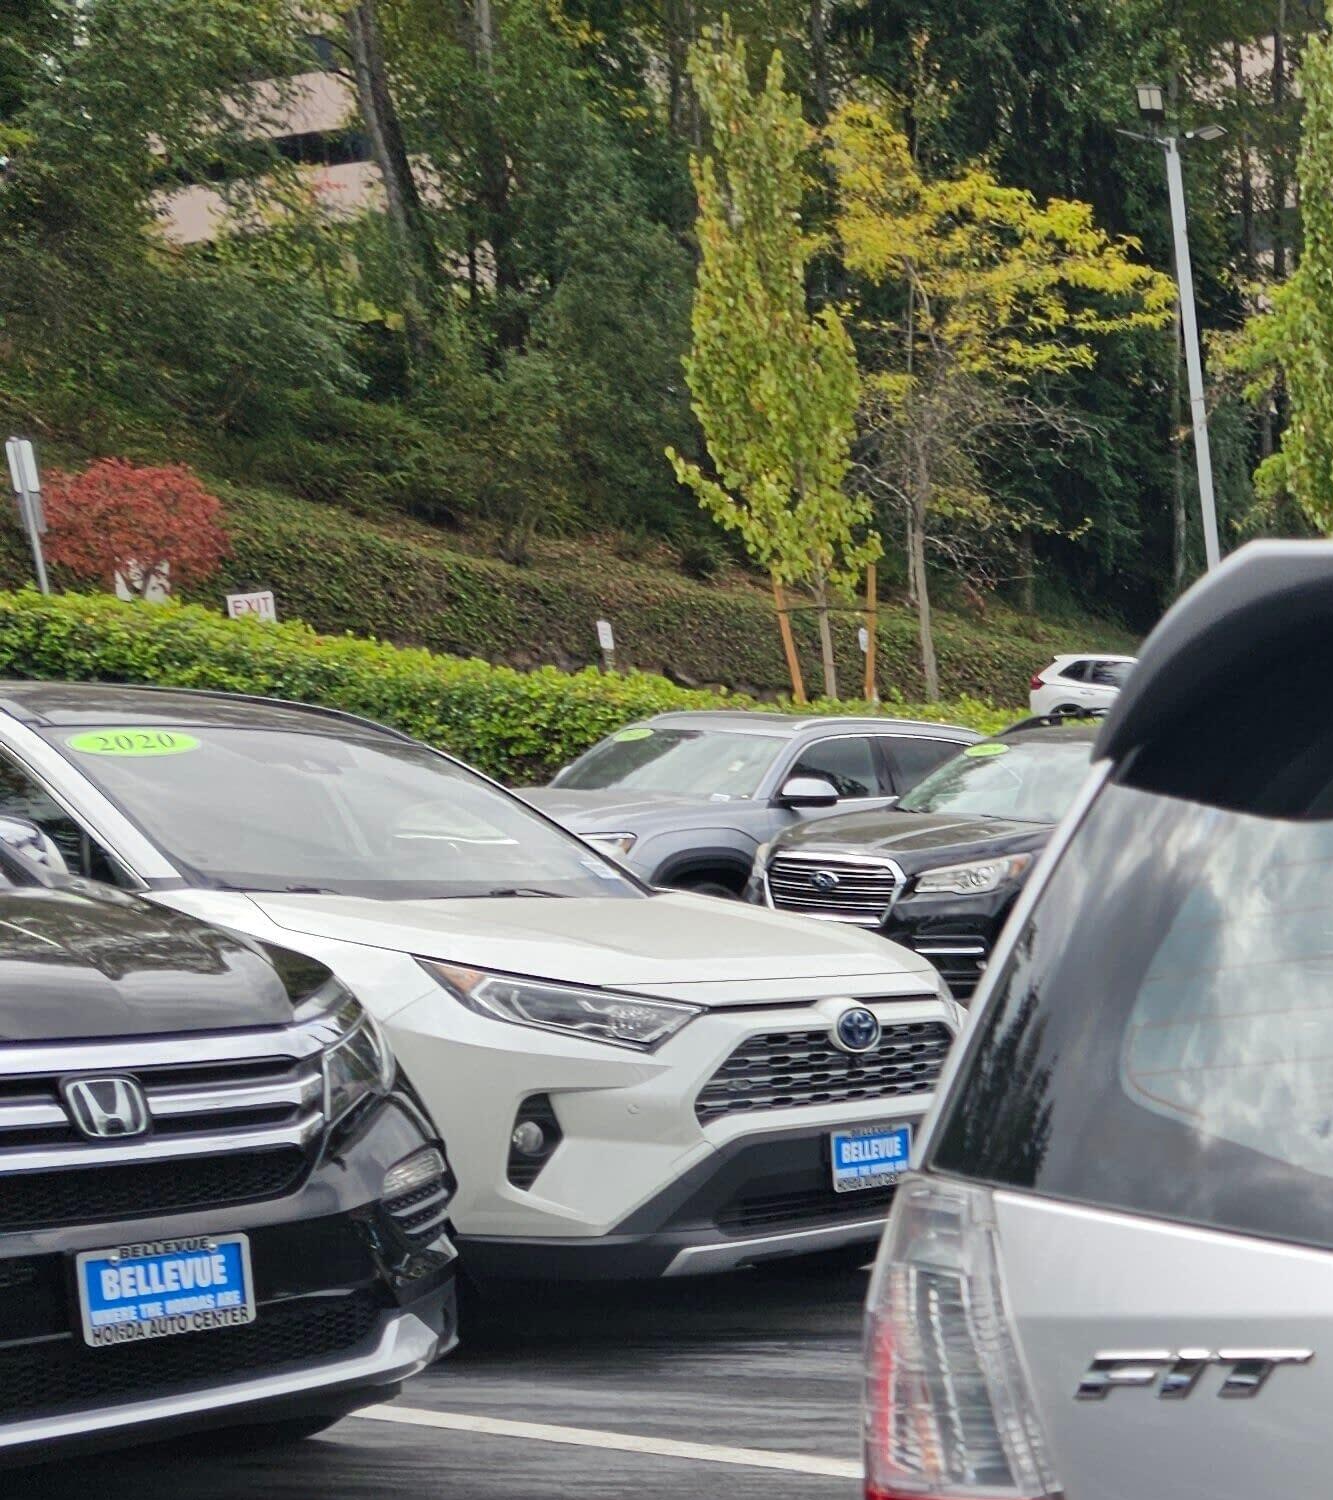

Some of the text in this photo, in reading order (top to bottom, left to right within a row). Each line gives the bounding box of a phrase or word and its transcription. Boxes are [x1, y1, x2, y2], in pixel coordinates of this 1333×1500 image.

[232, 597, 270, 616] EXIT
[95, 733, 176, 751] 2020
[841, 1136, 902, 1164] BELLEVUE
[119, 1237, 210, 1259] BELLEVUE
[100, 1255, 228, 1301] BELLEVUE
[93, 1307, 249, 1345] HONDA AUTO CENTER
[1074, 1348, 1315, 1400] FIT
